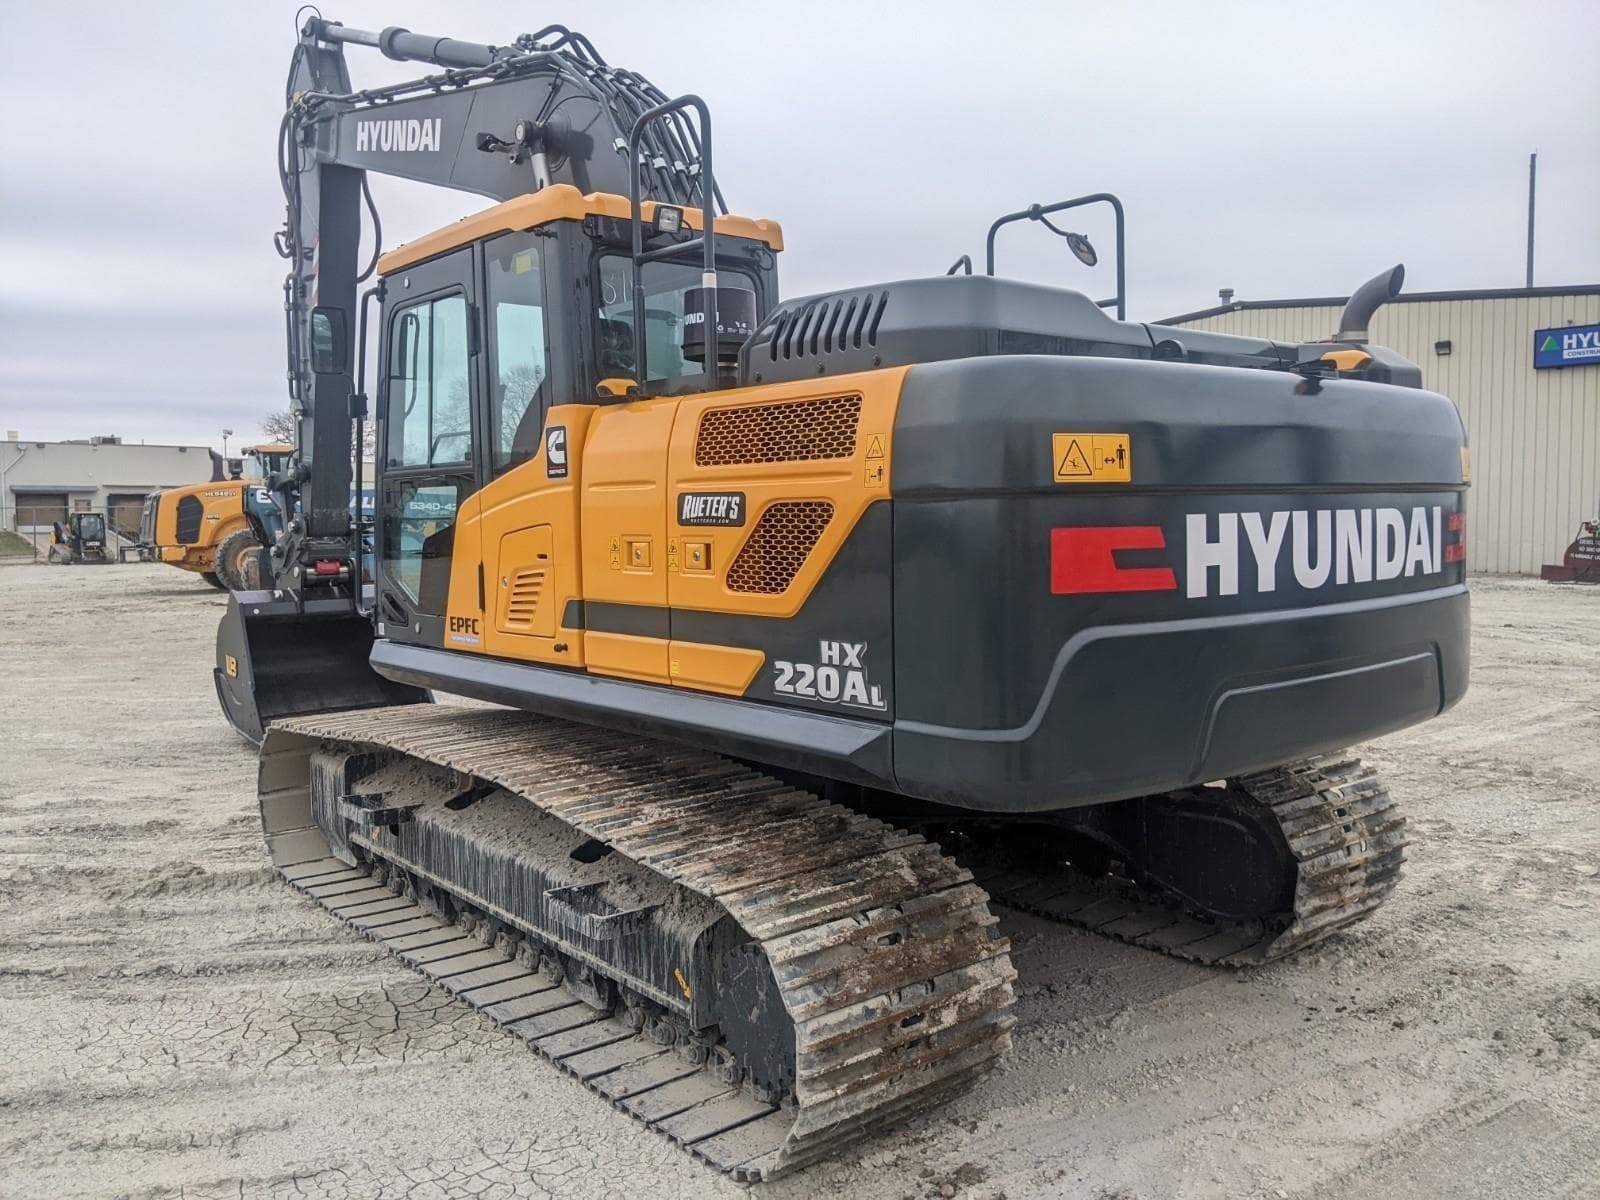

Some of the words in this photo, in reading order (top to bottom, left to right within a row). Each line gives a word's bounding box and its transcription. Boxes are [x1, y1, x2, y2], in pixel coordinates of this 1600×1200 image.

[356, 118, 442, 152] HYUNDAI
[682, 495, 740, 520] RUETER'S
[1186, 506, 1442, 599] HYUNDAI
[449, 616, 480, 636] EPFC
[820, 640, 865, 669] HX
